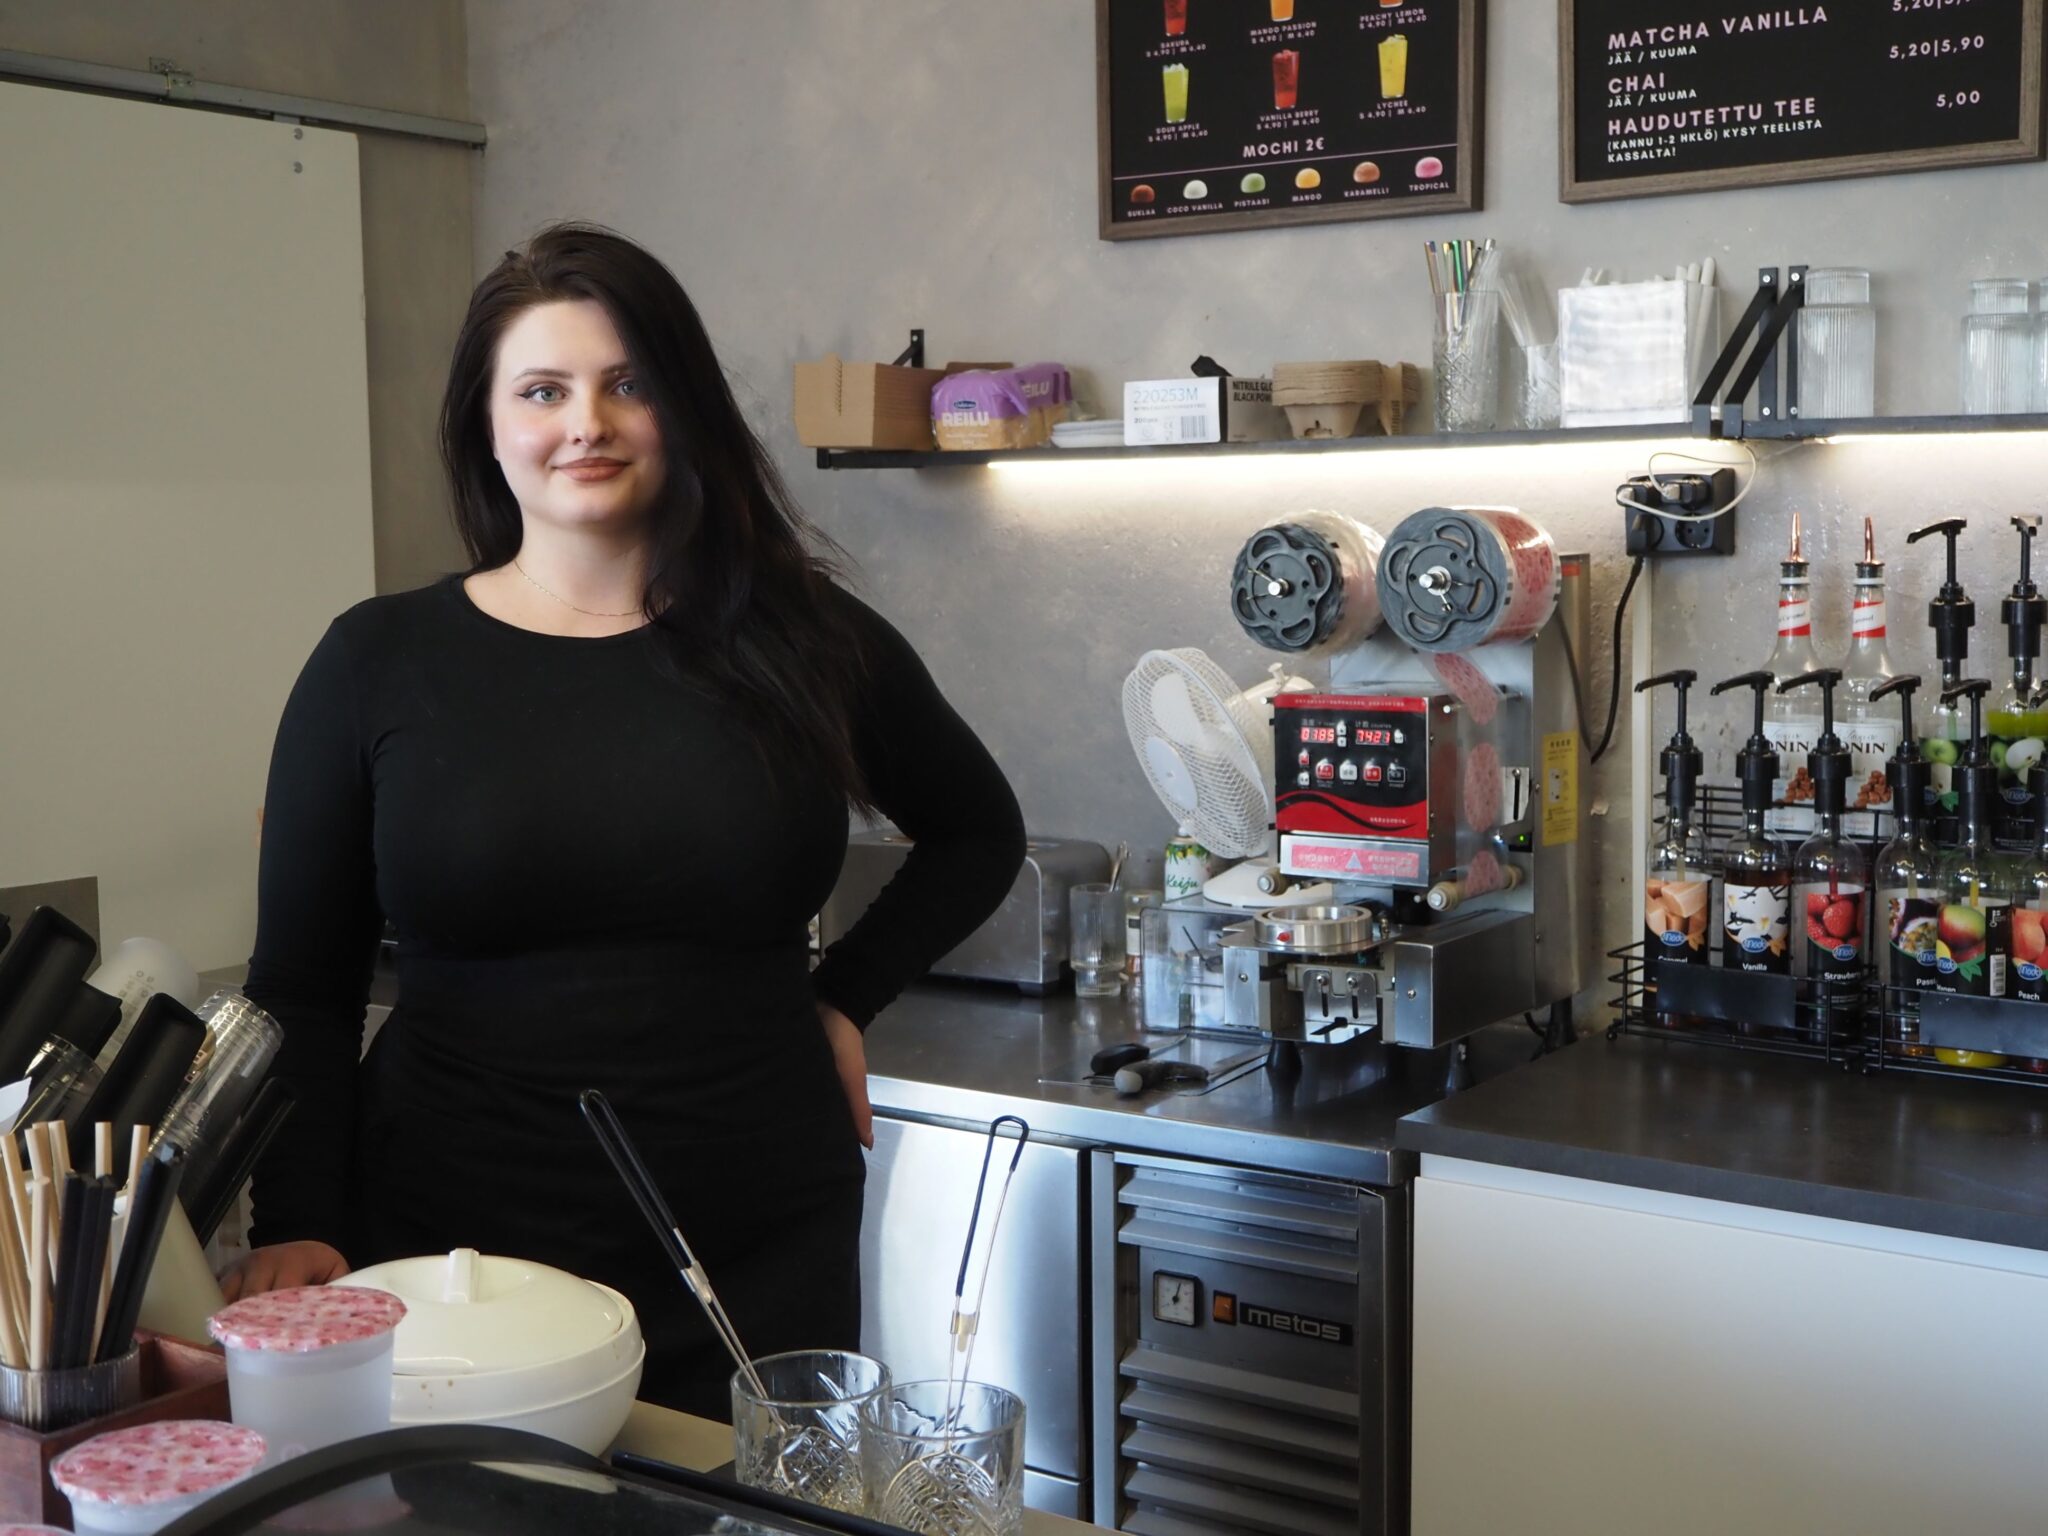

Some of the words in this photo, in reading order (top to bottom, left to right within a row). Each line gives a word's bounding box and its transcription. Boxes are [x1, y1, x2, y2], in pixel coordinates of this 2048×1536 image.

[1360, 12, 1392, 21] PEACHY
[1395, 8, 1424, 18] LEMON
[1250, 26, 1280, 36] MANGO
[1282, 21, 1318, 32] PASSION
[1608, 21, 1710, 50] MATCHA
[1722, 5, 1828, 35] VANILLA
[1161, 40, 1190, 49] SAKURA
[1889, 35, 1985, 59] 5,20|5,90
[1608, 52, 1632, 66] JÄÄ
[1650, 45, 1698, 60] KUUMA
[1608, 72, 1665, 95] CHAI
[1377, 100, 1408, 110] LYCHEE
[1608, 95, 1632, 108] JÄÄ
[1650, 88, 1698, 103] KUUMA
[1936, 90, 1981, 109] 5,00
[1260, 112, 1292, 123] VANILLA
[1295, 109, 1319, 120] BERRY
[1608, 103, 1763, 136] HAUDUTETTU
[1774, 97, 1816, 117] TEE
[1156, 126, 1177, 134] SOUR
[1178, 123, 1200, 131] APPLE
[1608, 137, 1654, 152] (KANNU
[1658, 135, 1676, 145] 1-2
[1680, 128, 1718, 143] HKLÖ)
[1723, 126, 1758, 139] KYSY
[1762, 119, 1823, 134] TEELISTA
[1243, 140, 1299, 158] MOCHI
[1305, 137, 1325, 152] 2€
[1608, 146, 1676, 163] KASSALTA!
[1344, 187, 1390, 198] KARAMELLI
[1409, 181, 1450, 192] TROPICAL
[1234, 198, 1270, 208] PISTAASI
[1292, 193, 1322, 202] MANGO
[1127, 208, 1156, 217] SUKLAA
[1167, 205, 1190, 214] COCO
[1191, 202, 1223, 212] VANILLA
[1233, 381, 1260, 391] NITRILE
[1133, 387, 1199, 404] 220253M
[1233, 392, 1255, 402] BLACK
[942, 411, 990, 428] REILU
[1742, 962, 1768, 971] Vanilla
[2018, 990, 2040, 1001] Peach
[1248, 1308, 1341, 1342] metos
